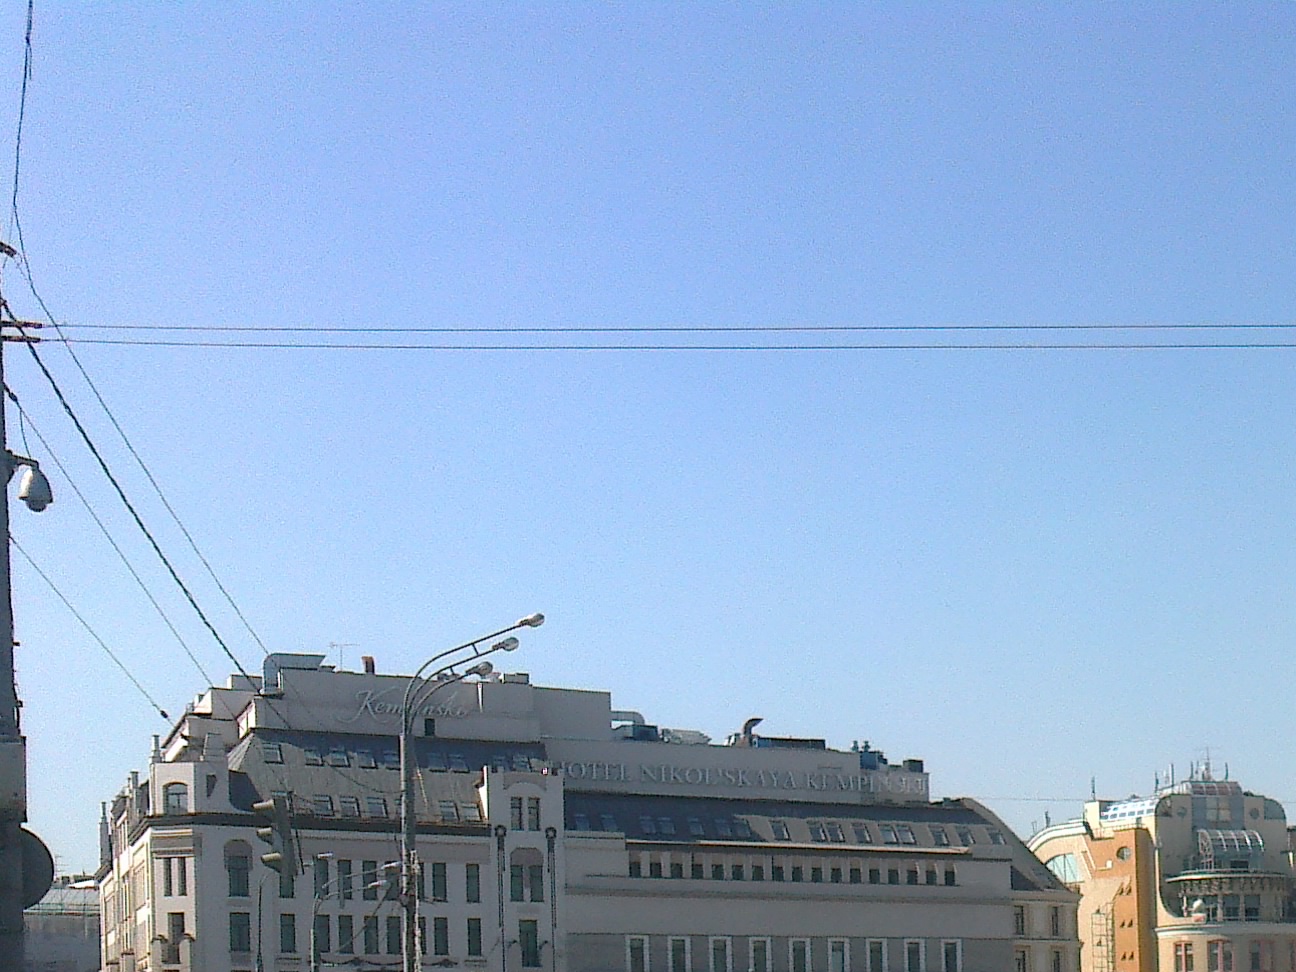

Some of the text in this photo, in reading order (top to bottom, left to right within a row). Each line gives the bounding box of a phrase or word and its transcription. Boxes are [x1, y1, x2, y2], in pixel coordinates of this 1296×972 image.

[337, 686, 468, 724] Keminski
[550, 760, 630, 781] HOTEL
[806, 773, 927, 795] KEMPINSKI
